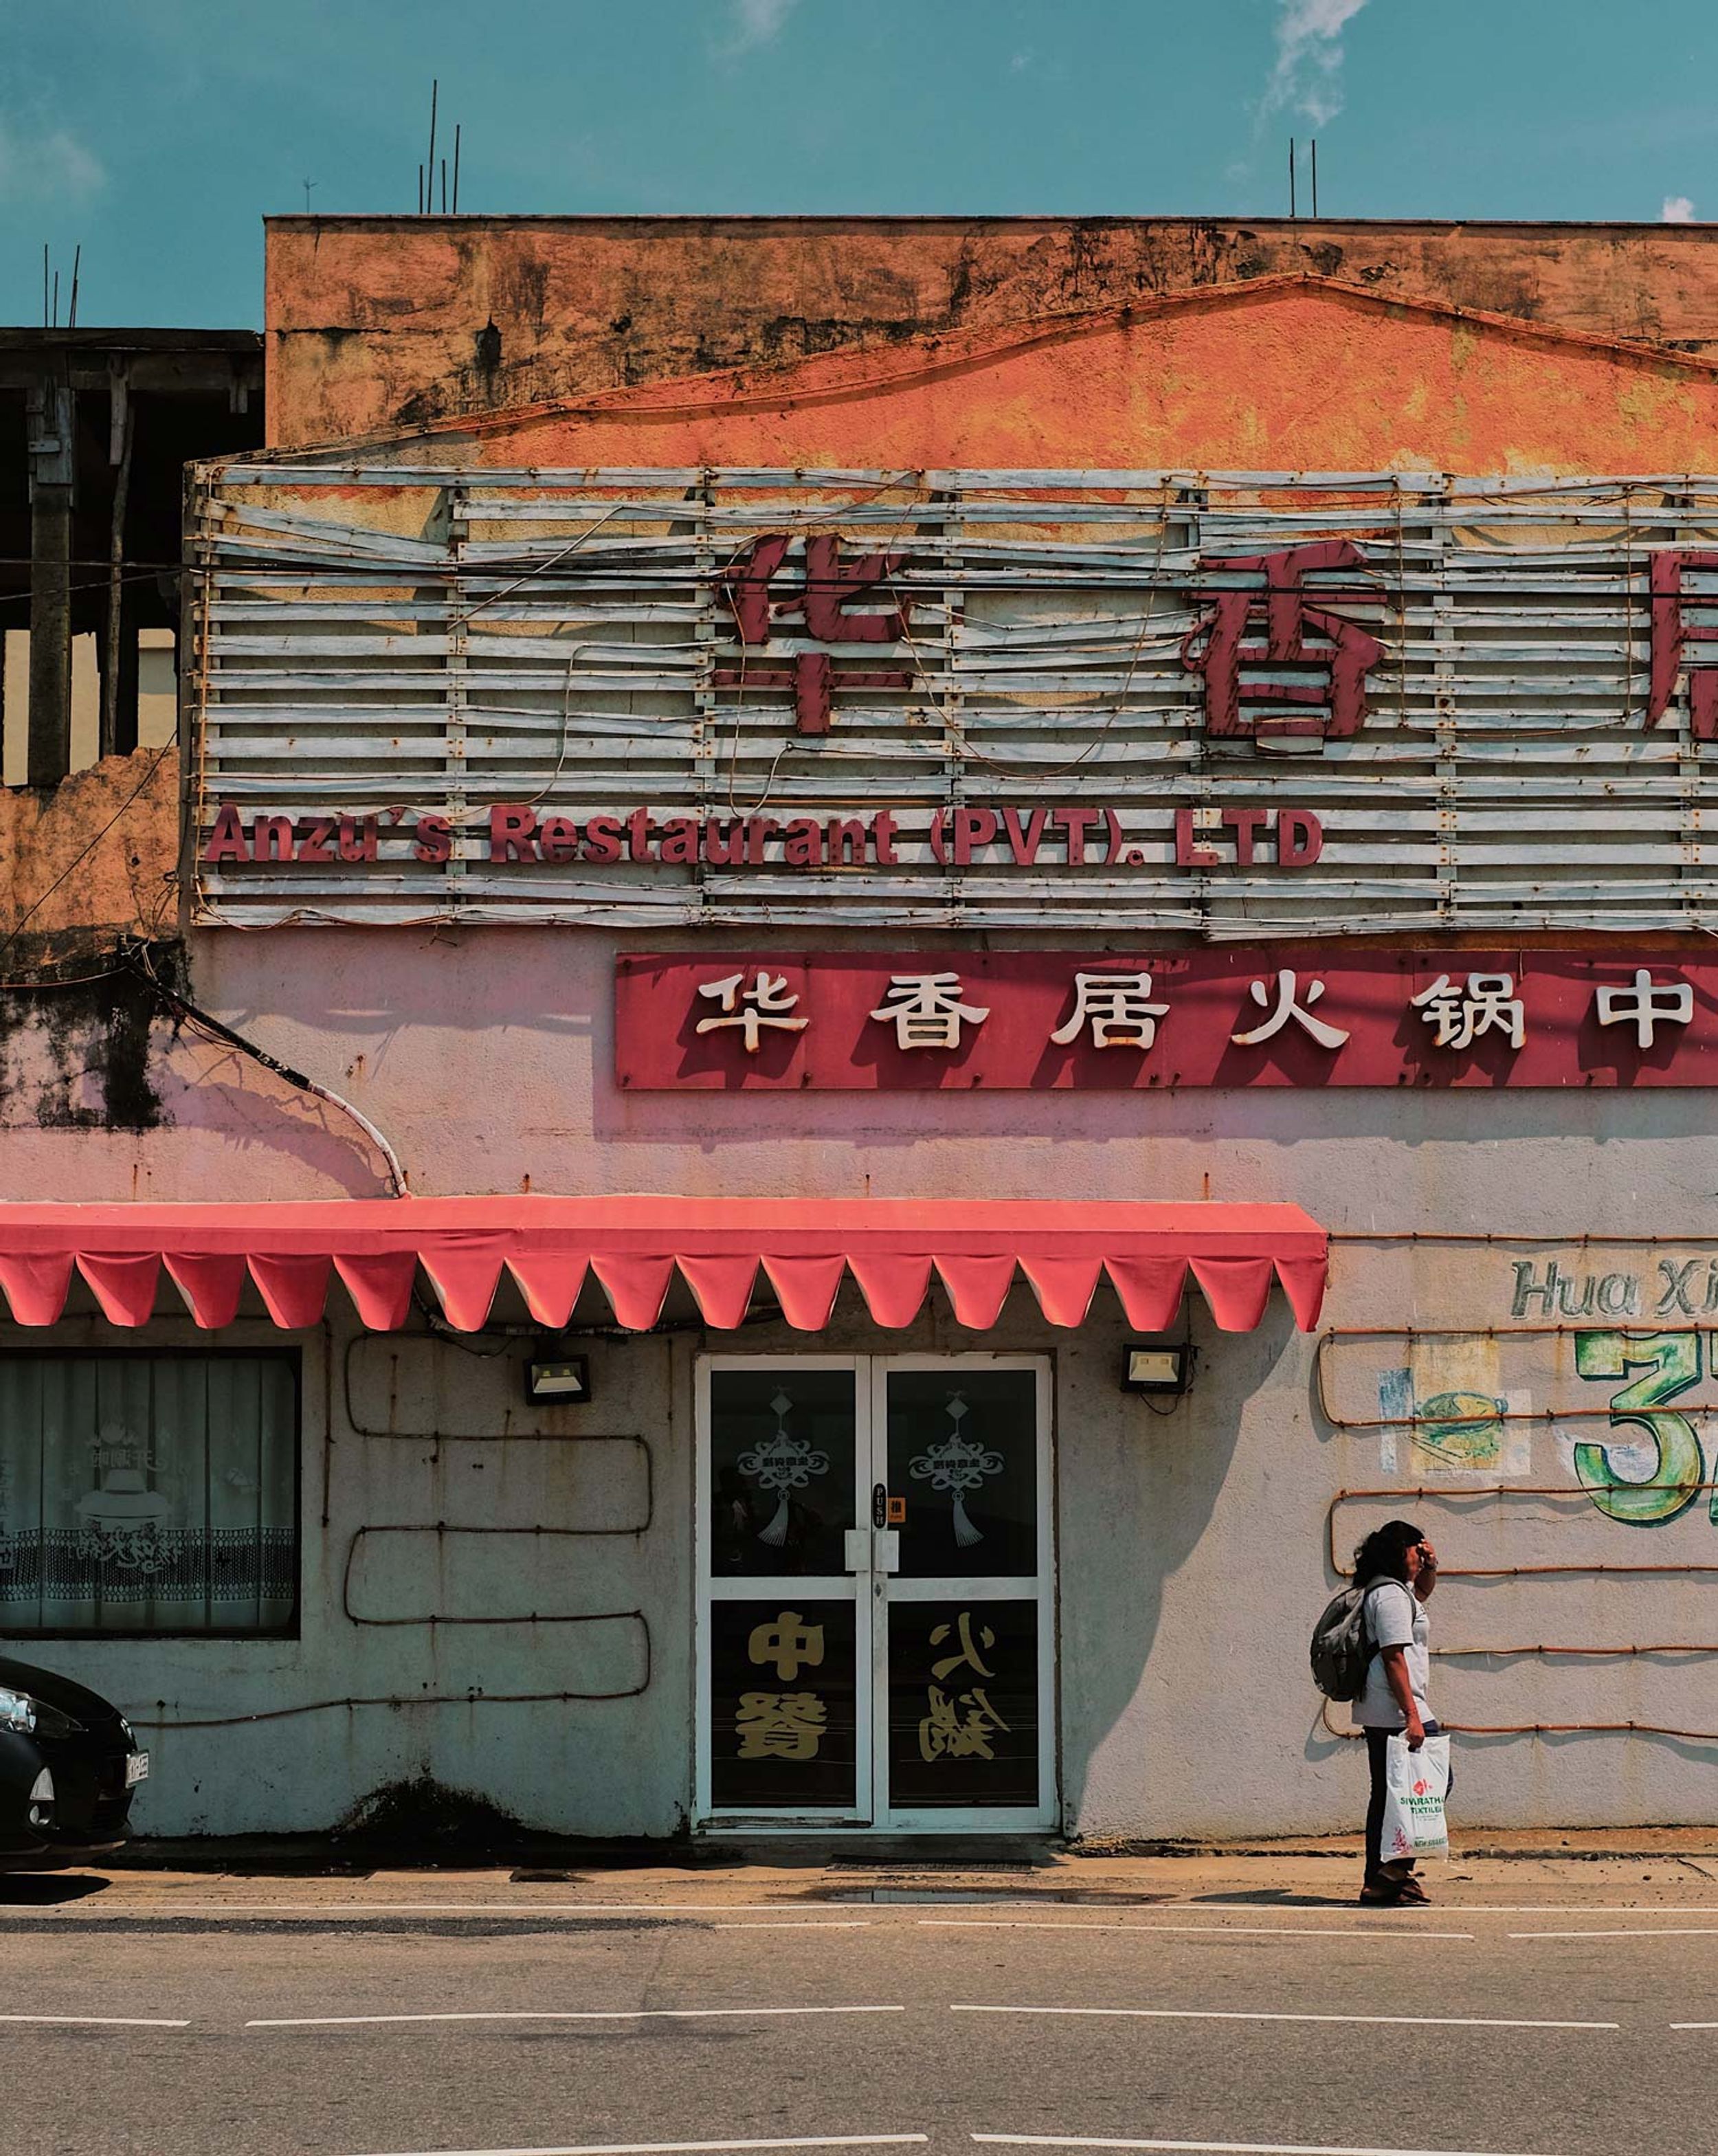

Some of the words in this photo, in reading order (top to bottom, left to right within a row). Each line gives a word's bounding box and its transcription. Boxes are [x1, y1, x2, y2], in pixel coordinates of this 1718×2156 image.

[204, 803, 452, 863] Anzu's
[489, 805, 897, 866] Restaurant
[1175, 808, 1324, 867] LTD
[695, 968, 1694, 1054] 华香居火锅中
[1510, 1260, 1639, 1320] Hua
[1574, 1331, 1718, 1528] 3
[875, 1487, 884, 1525] PUSH
